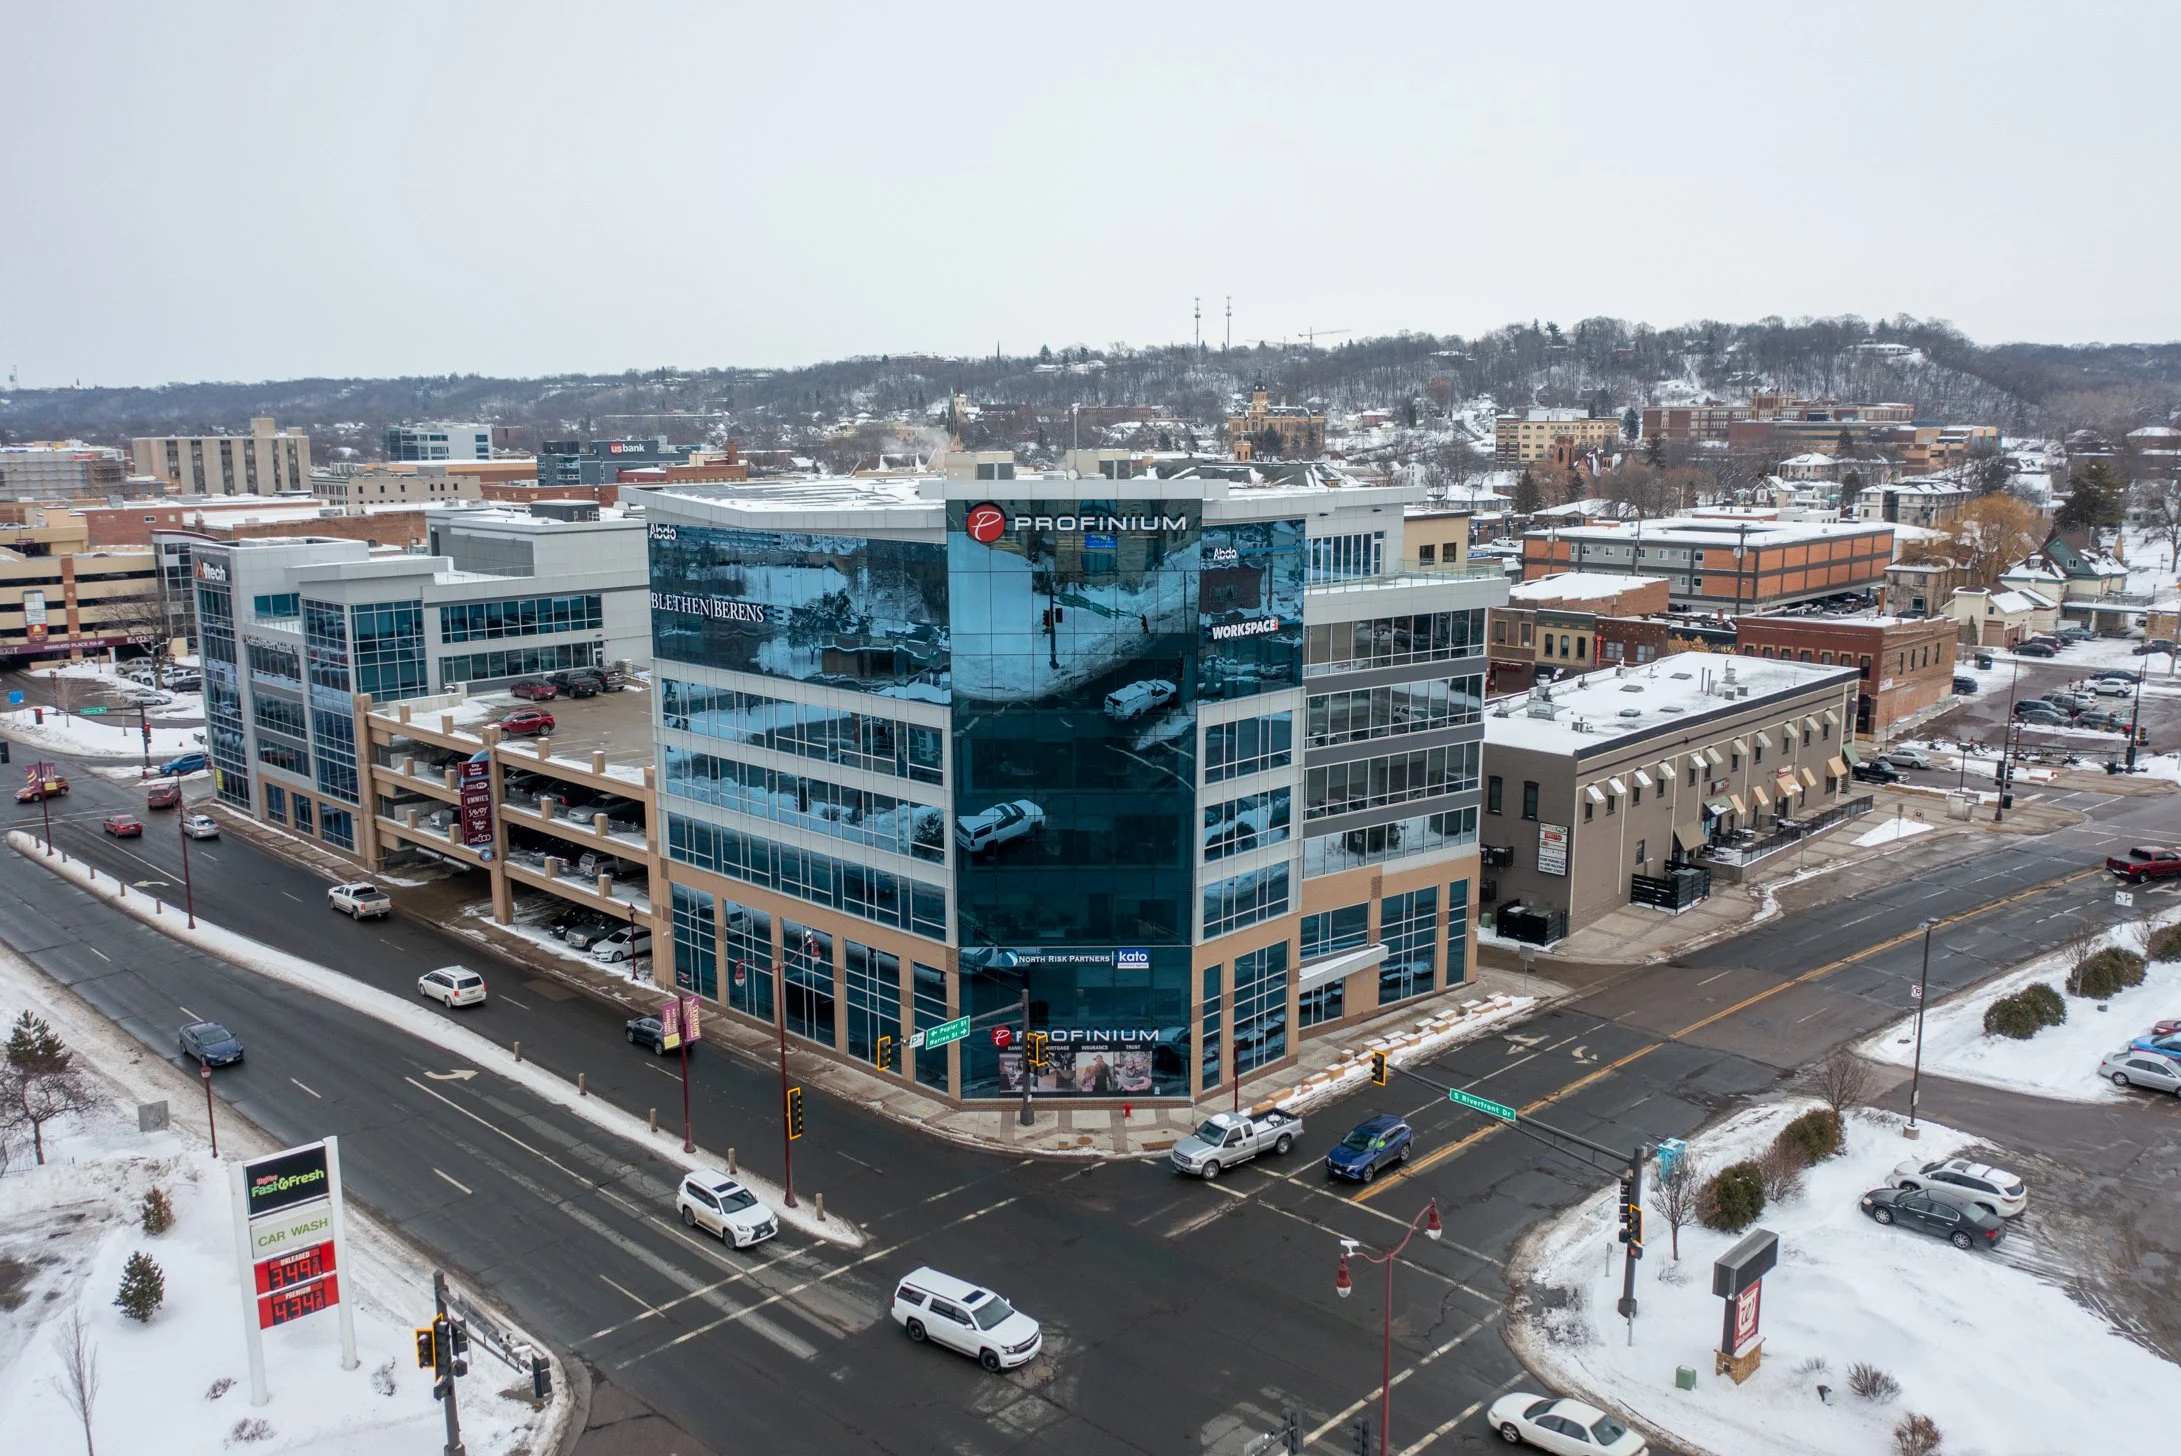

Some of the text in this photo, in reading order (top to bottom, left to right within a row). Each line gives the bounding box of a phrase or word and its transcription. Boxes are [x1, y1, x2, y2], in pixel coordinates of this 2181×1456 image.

[1014, 516, 1187, 531] PROFINIUM
[649, 523, 677, 540] Abdo
[1213, 546, 1237, 560] Abdo
[1212, 619, 1276, 640] WORKSPACE
[469, 806, 488, 817] SAVOY
[1018, 955, 1046, 963] NORTH
[1119, 951, 1147, 962] kato
[940, 1023, 958, 1033] Poplar
[929, 1035, 950, 1046] Warren
[1454, 1092, 1512, 1117] S Riverfront Dr
[258, 1217, 328, 1247] CAR WASH
[281, 1250, 310, 1266] UNLEADED
